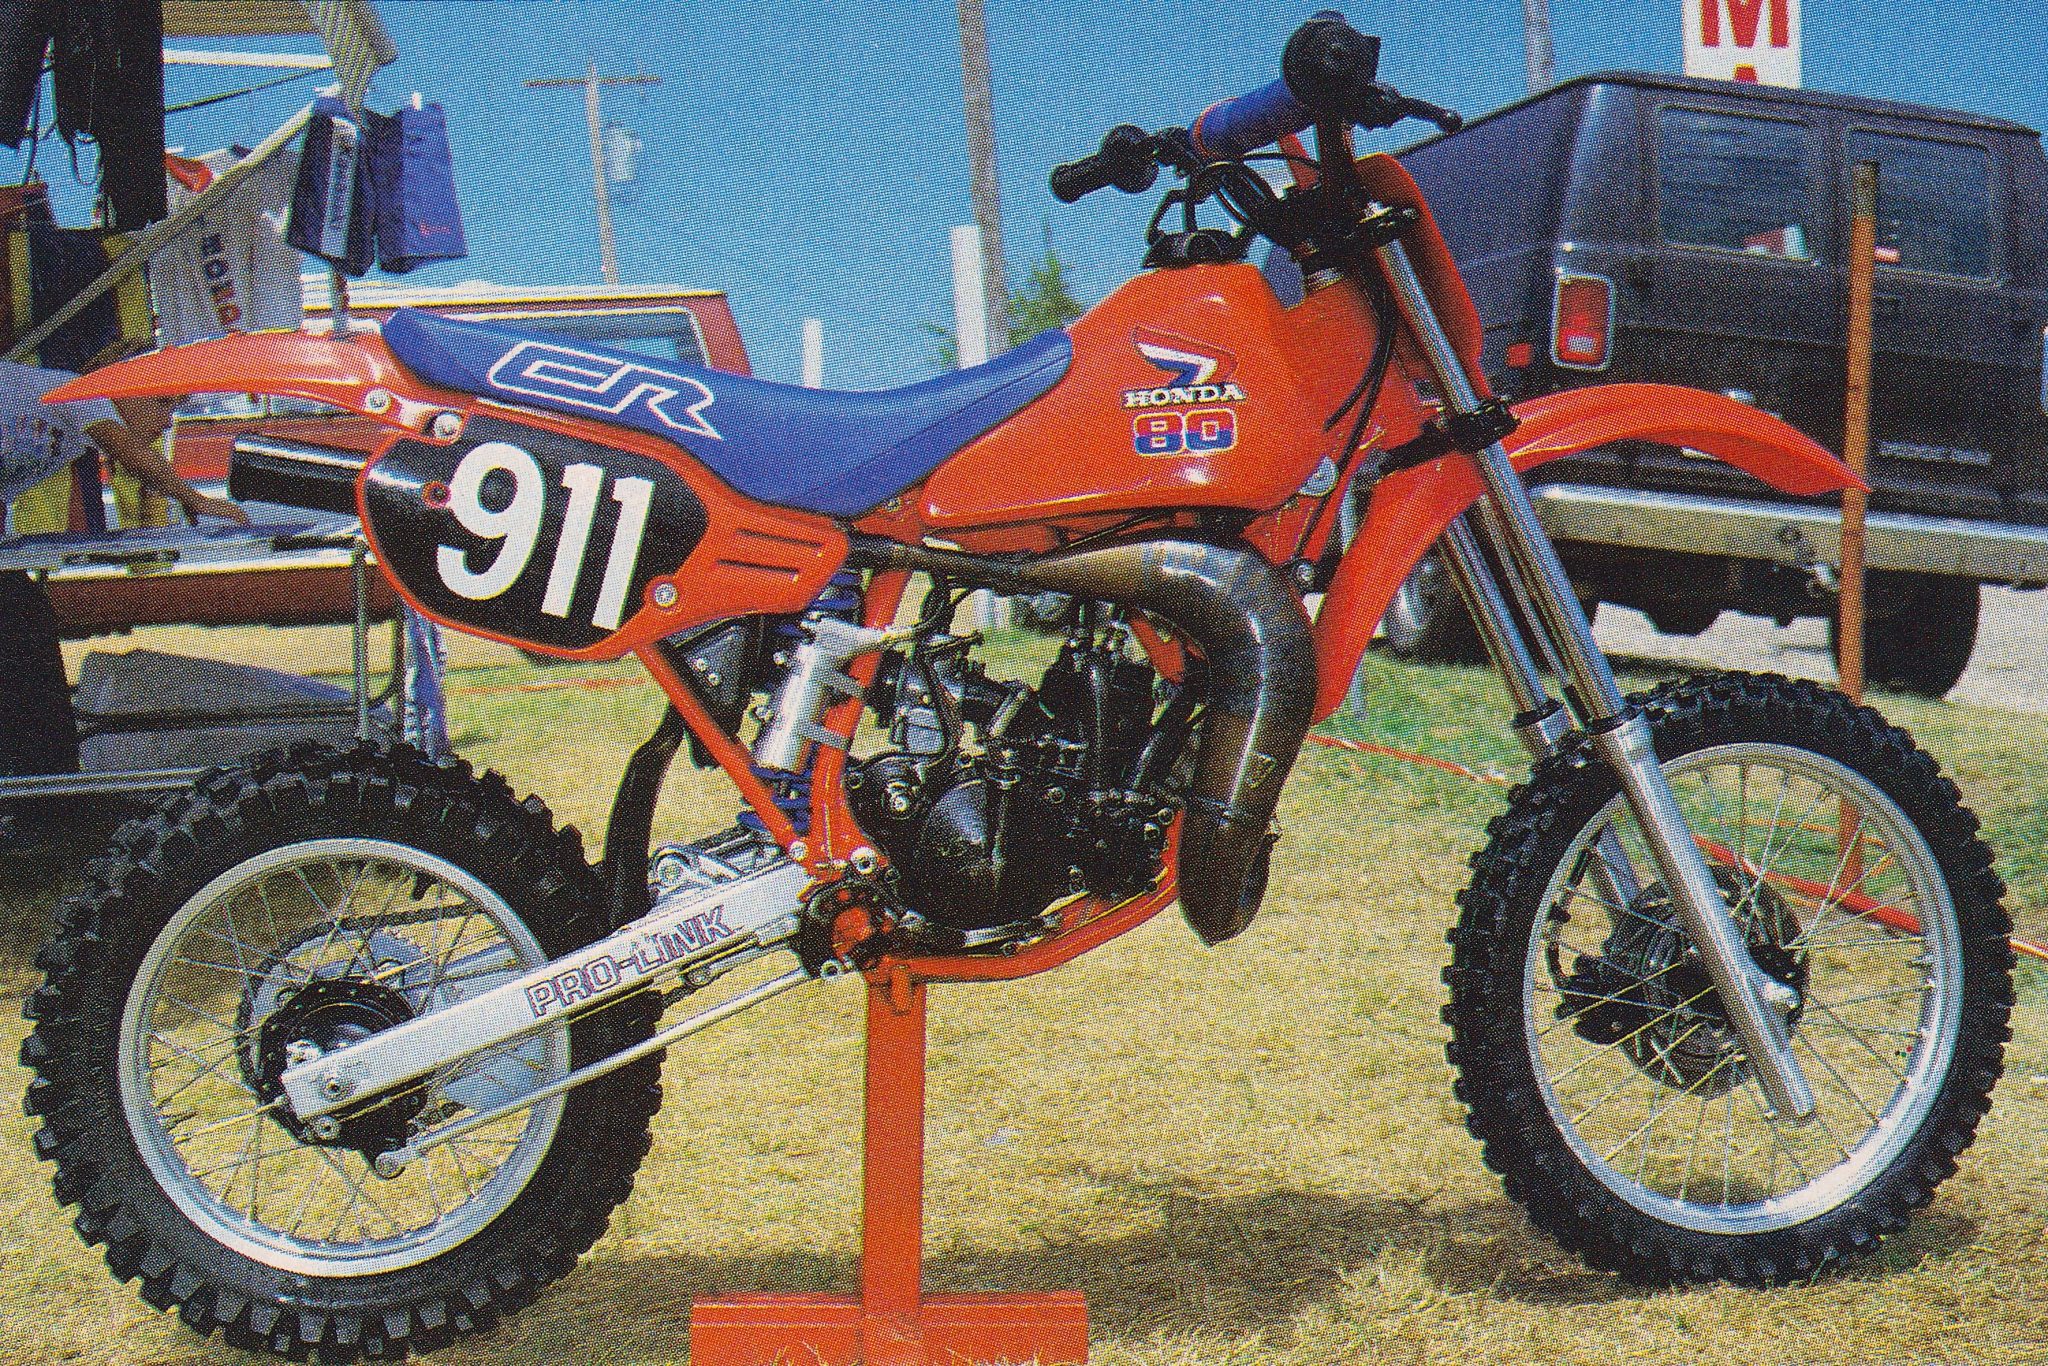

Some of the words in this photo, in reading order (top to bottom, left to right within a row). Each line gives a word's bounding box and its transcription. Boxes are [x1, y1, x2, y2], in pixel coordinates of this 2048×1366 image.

[488, 341, 723, 439] CR
[1124, 383, 1246, 407] HONDA
[1134, 408, 1238, 458] 80
[437, 442, 655, 631] 911
